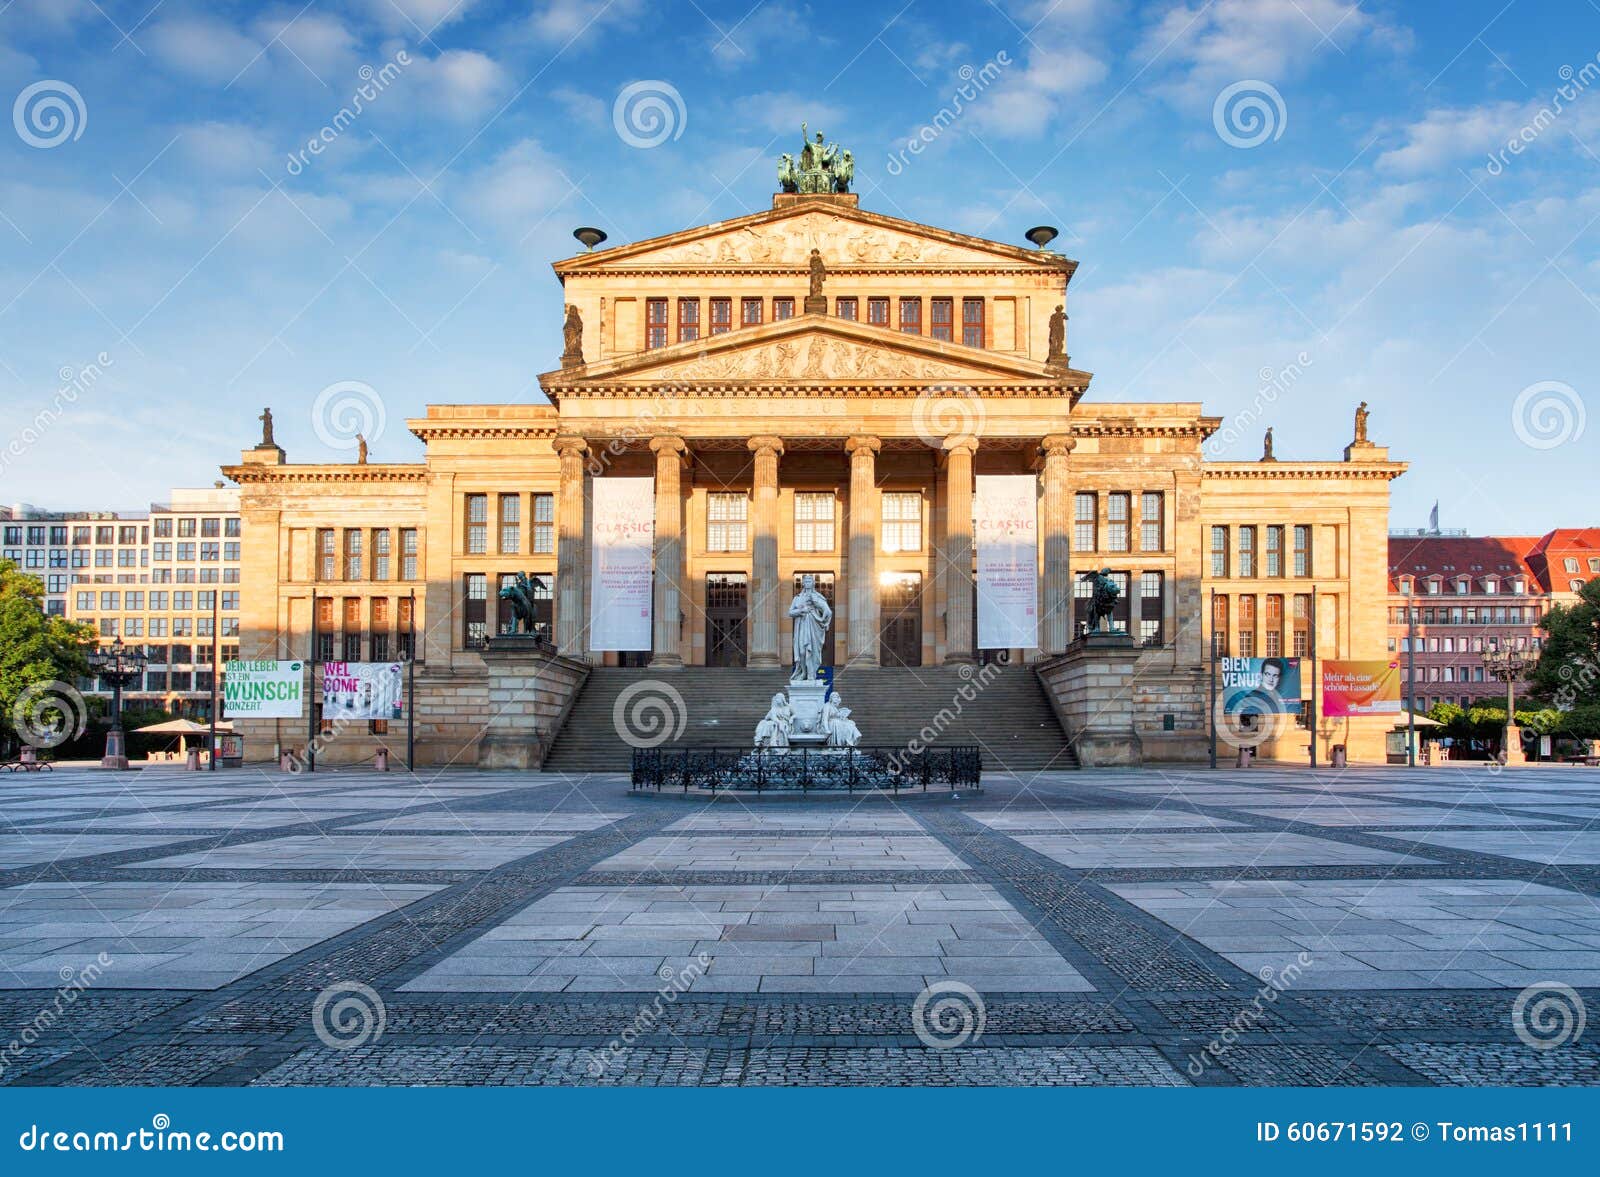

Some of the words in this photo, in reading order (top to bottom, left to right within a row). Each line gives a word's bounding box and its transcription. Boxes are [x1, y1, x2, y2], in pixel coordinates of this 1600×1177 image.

[596, 522, 650, 533] CLASSIC
[980, 519, 1033, 530] CLASSIC
[225, 660, 247, 672] DEIN
[249, 660, 279, 672] LEBEN
[323, 661, 350, 676] WEL
[1222, 657, 1250, 672] BIEN
[239, 672, 250, 680] EIN
[1222, 672, 1262, 688] VENUE
[1324, 672, 1343, 681] Mehr
[1345, 672, 1355, 682] als
[1356, 673, 1372, 681] eine
[224, 681, 300, 701] WUNSCH
[323, 678, 360, 692] COME
[1324, 682, 1349, 691] schöne
